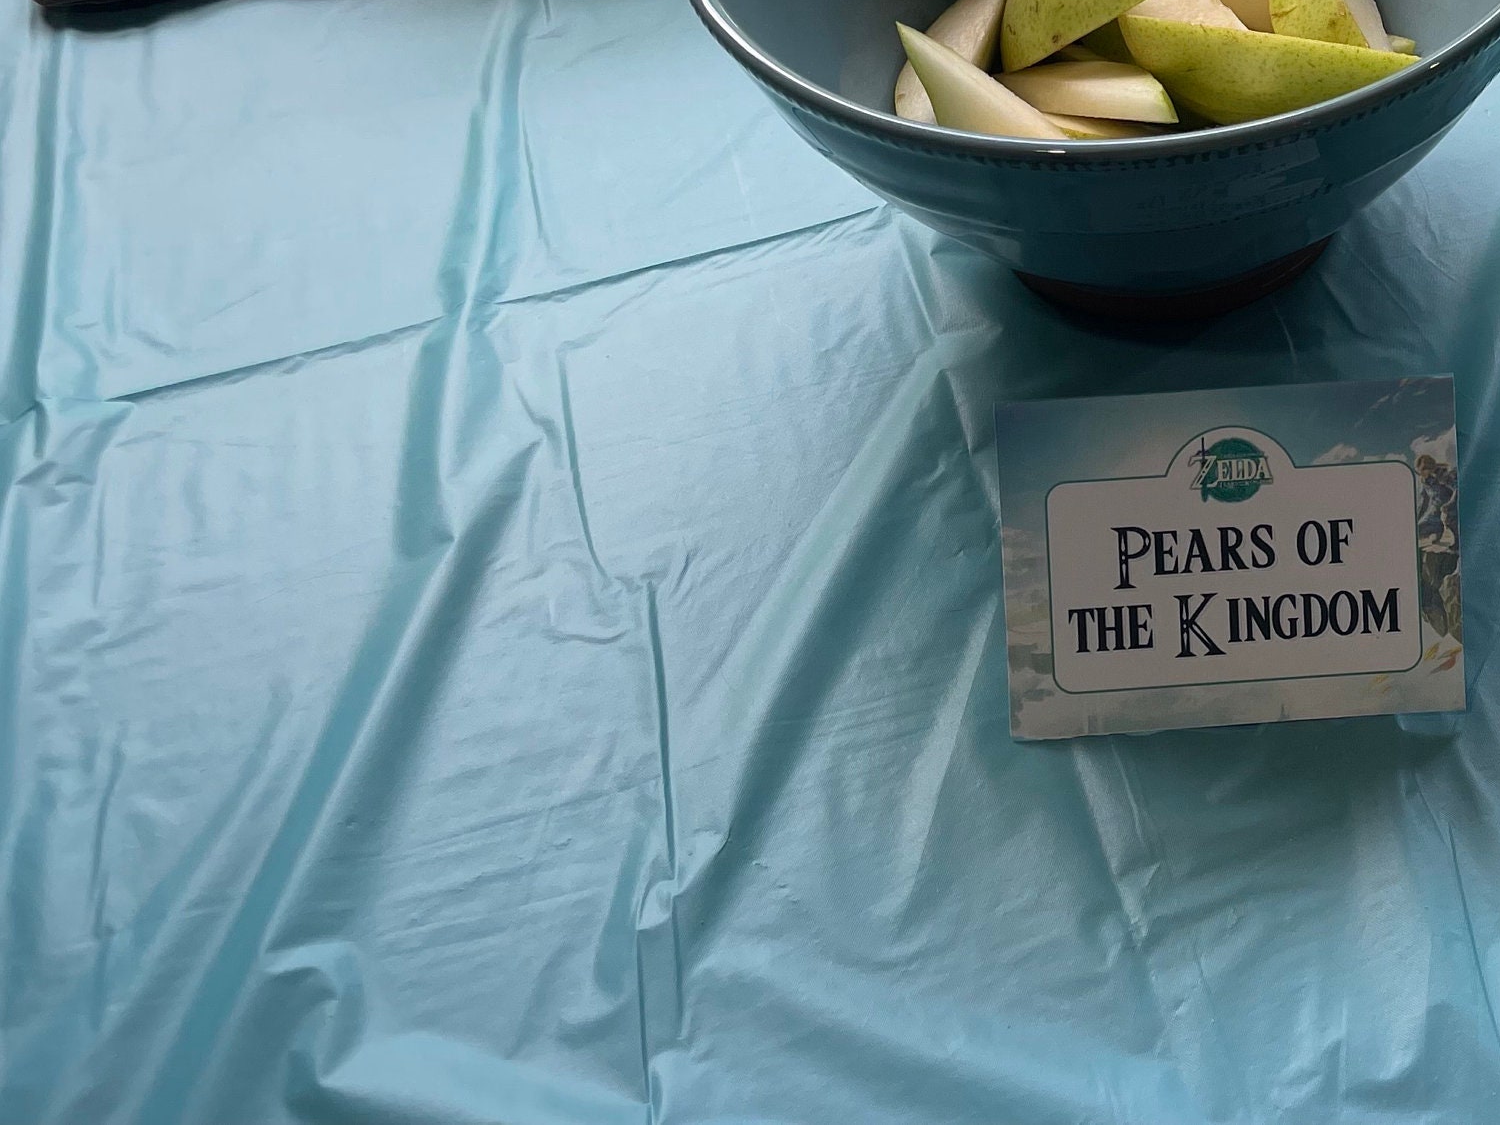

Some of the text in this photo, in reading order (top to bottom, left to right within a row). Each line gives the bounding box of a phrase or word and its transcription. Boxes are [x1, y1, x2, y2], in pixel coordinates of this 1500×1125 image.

[1187, 455, 1274, 490] ZELDA
[1111, 518, 1354, 590] PEARS OF
[1067, 587, 1401, 659] THE KINGDOM
